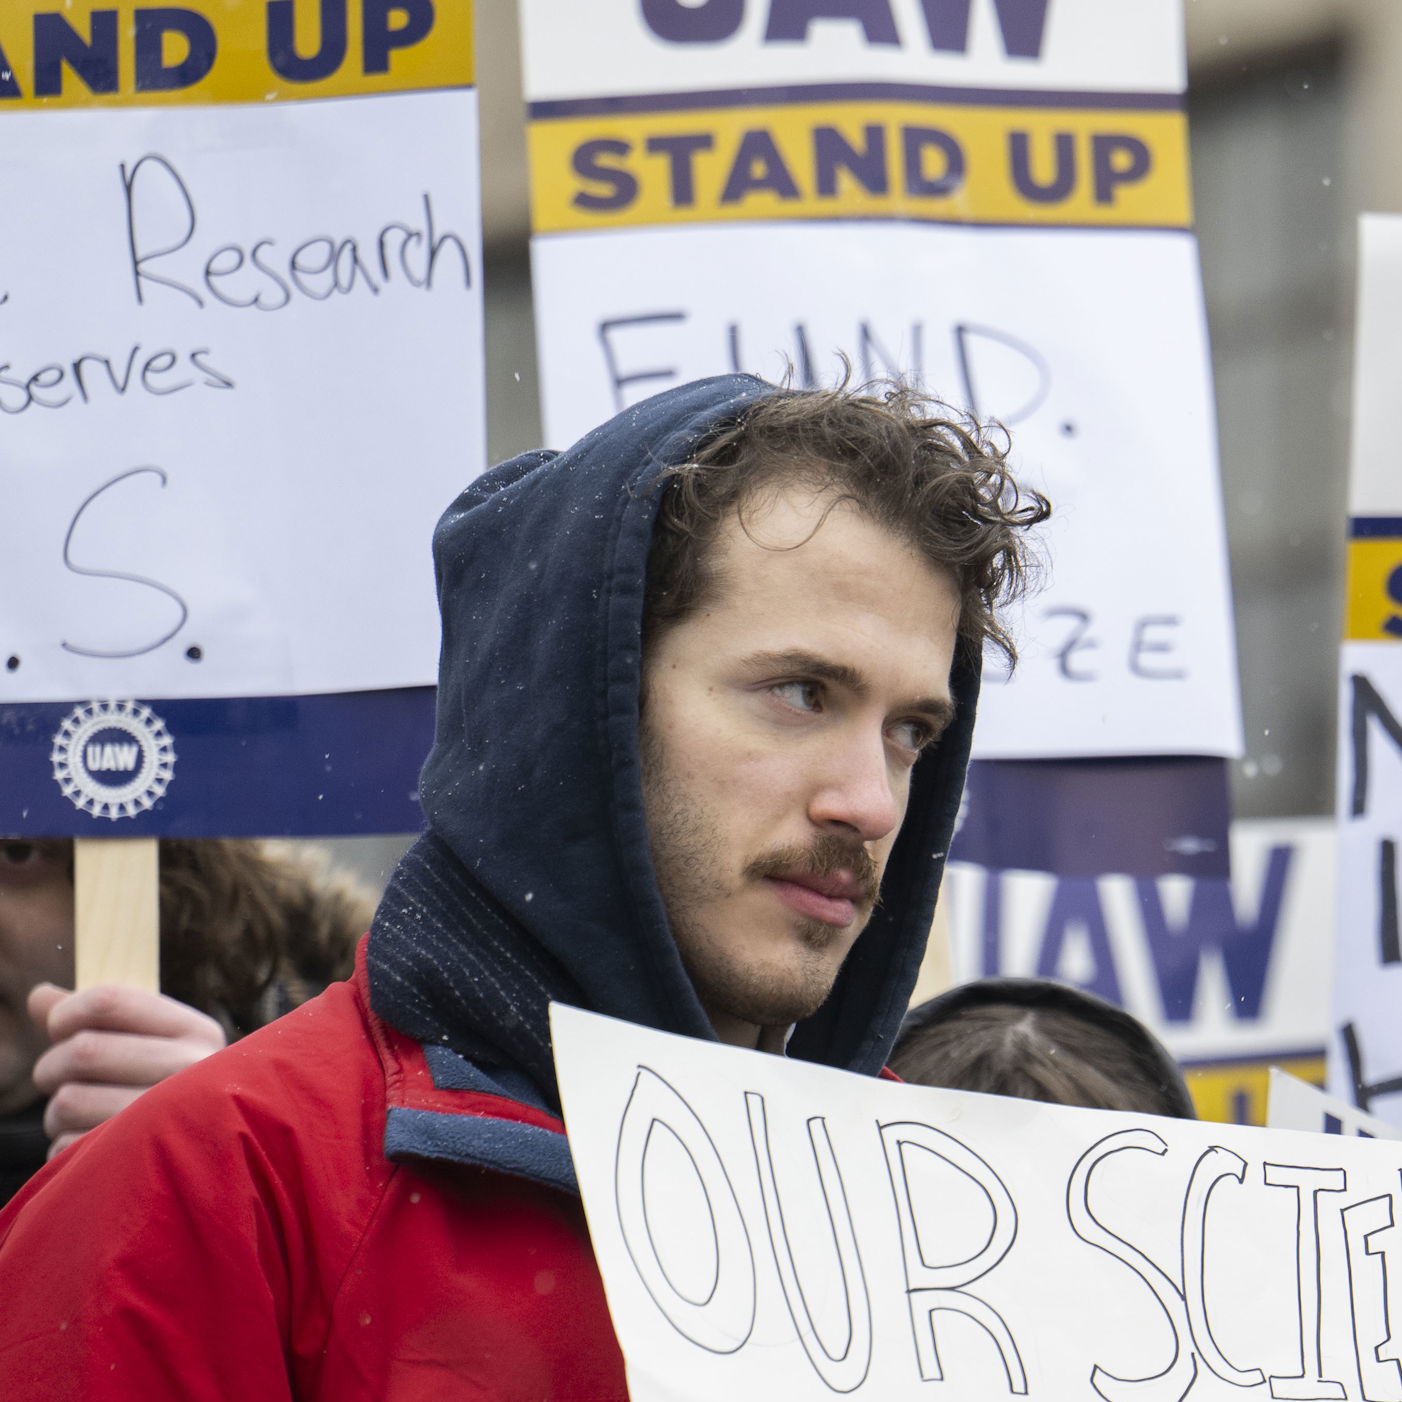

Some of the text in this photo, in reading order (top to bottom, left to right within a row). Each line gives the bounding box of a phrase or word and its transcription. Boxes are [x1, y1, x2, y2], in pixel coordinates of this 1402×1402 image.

[266, 0, 435, 84] UP
[571, 126, 1153, 211] STAND UP
[118, 152, 472, 311] Research
[84, 740, 140, 774] UAW
[615, 1065, 1029, 1393] OUR
